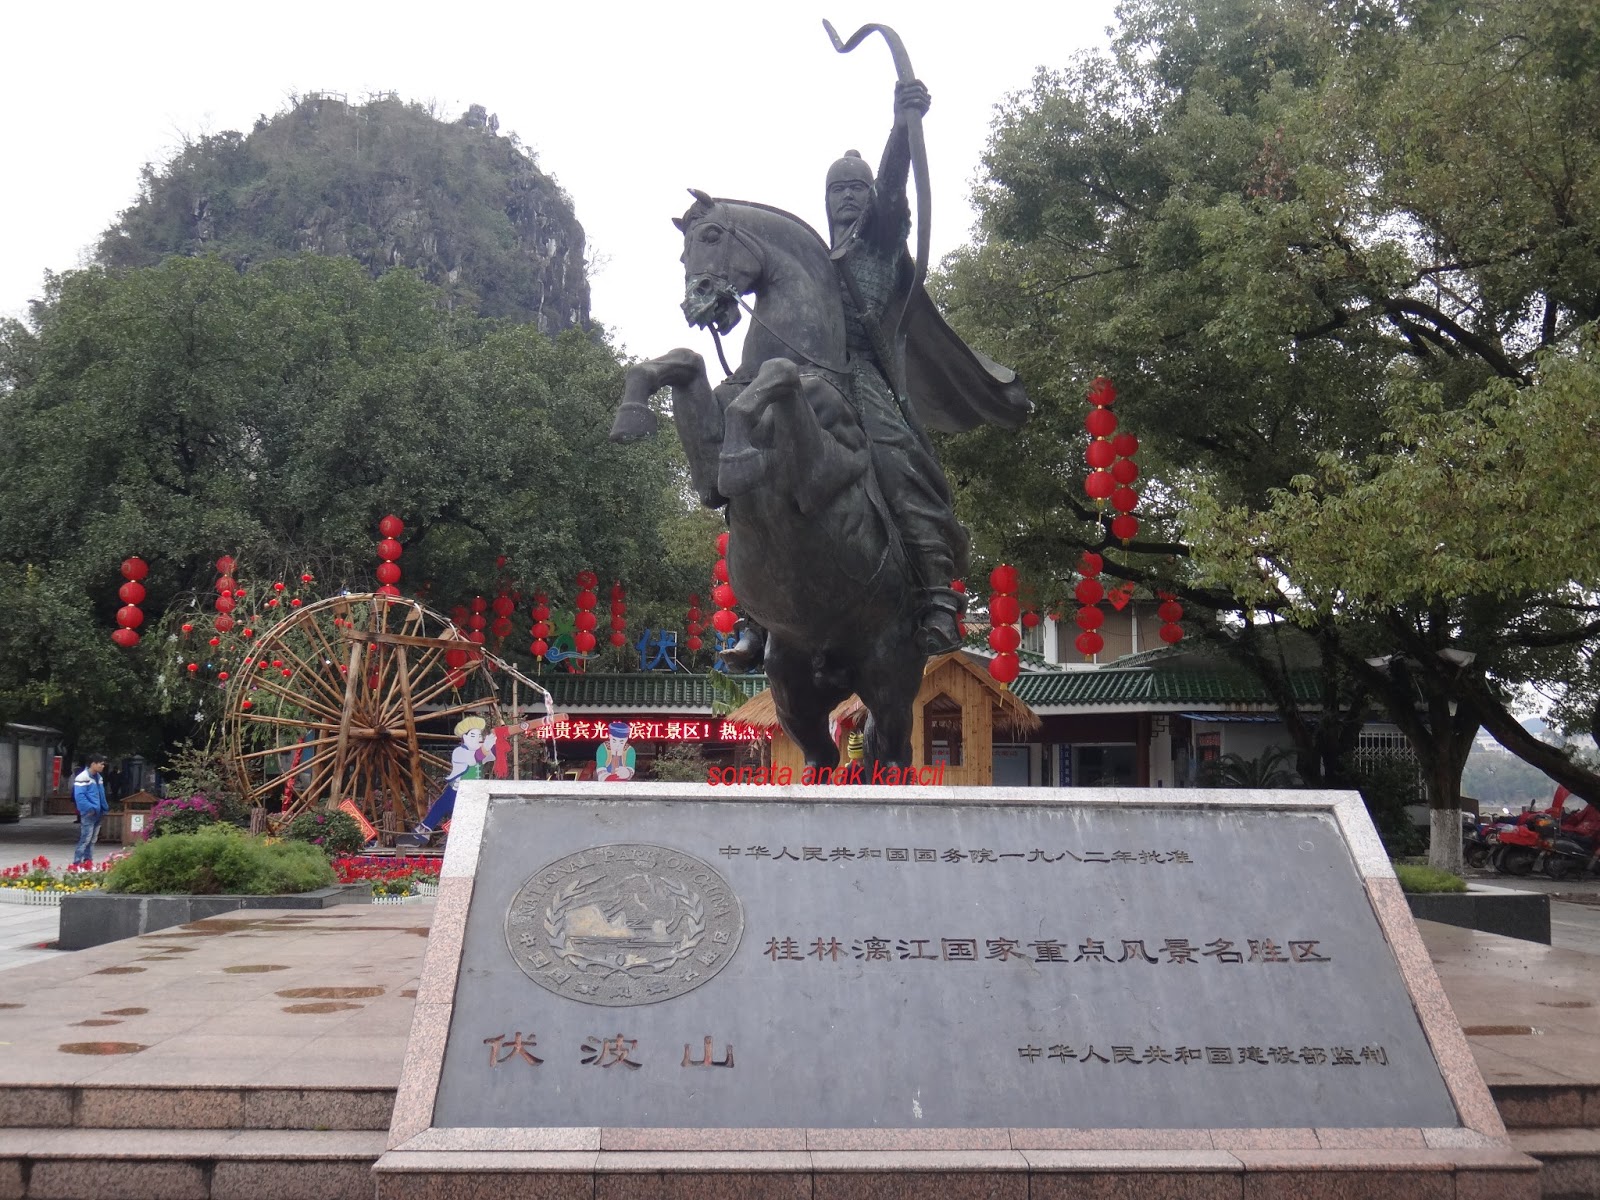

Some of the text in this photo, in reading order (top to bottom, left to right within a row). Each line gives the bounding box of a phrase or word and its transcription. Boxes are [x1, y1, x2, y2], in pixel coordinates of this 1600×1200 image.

[718, 844, 1194, 866] 中华人民共和国国务院一九八二年批准
[519, 855, 595, 919] NATIONAL
[693, 873, 731, 919] CHINA
[763, 936, 1331, 965] 桂林漓江国家重点风景名胜区
[483, 1032, 735, 1069] 伏波山
[1018, 1043, 1390, 1067] 中华人民共和国建设部监制
